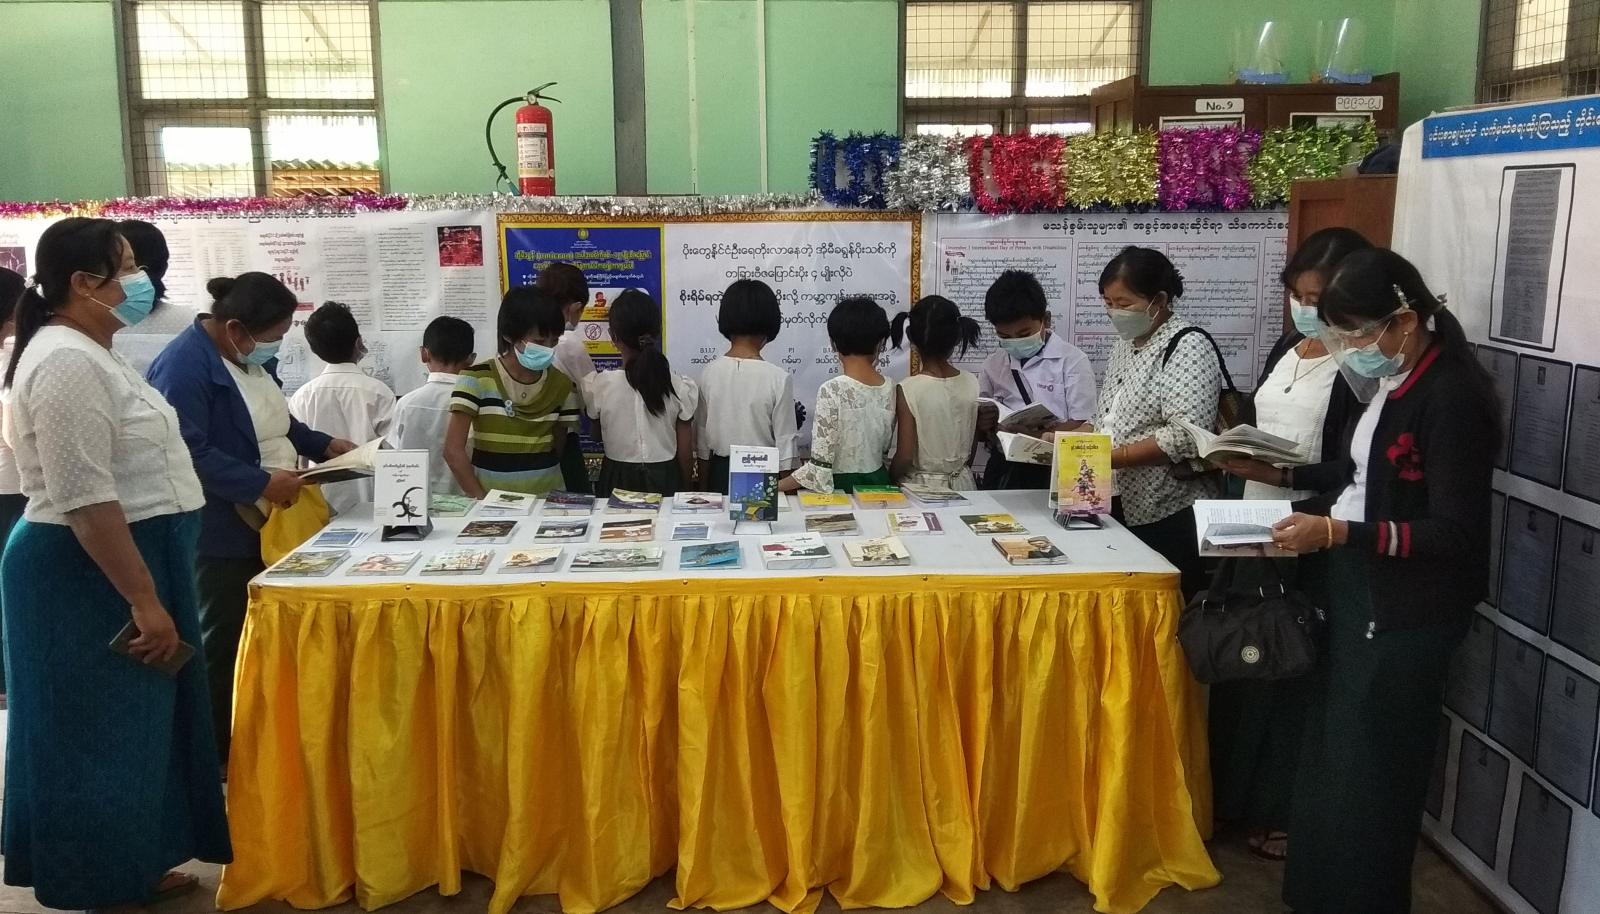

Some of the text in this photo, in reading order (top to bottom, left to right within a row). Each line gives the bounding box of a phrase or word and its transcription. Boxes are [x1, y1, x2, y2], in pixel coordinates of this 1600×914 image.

[1206, 100, 1234, 111] No.9
[1042, 217, 1128, 235] မသန်စွမ်းသူများ၏
[680, 289, 724, 306] စိုးရိမ်ရတဲ
[815, 354, 839, 364] ဒယ်လ်
